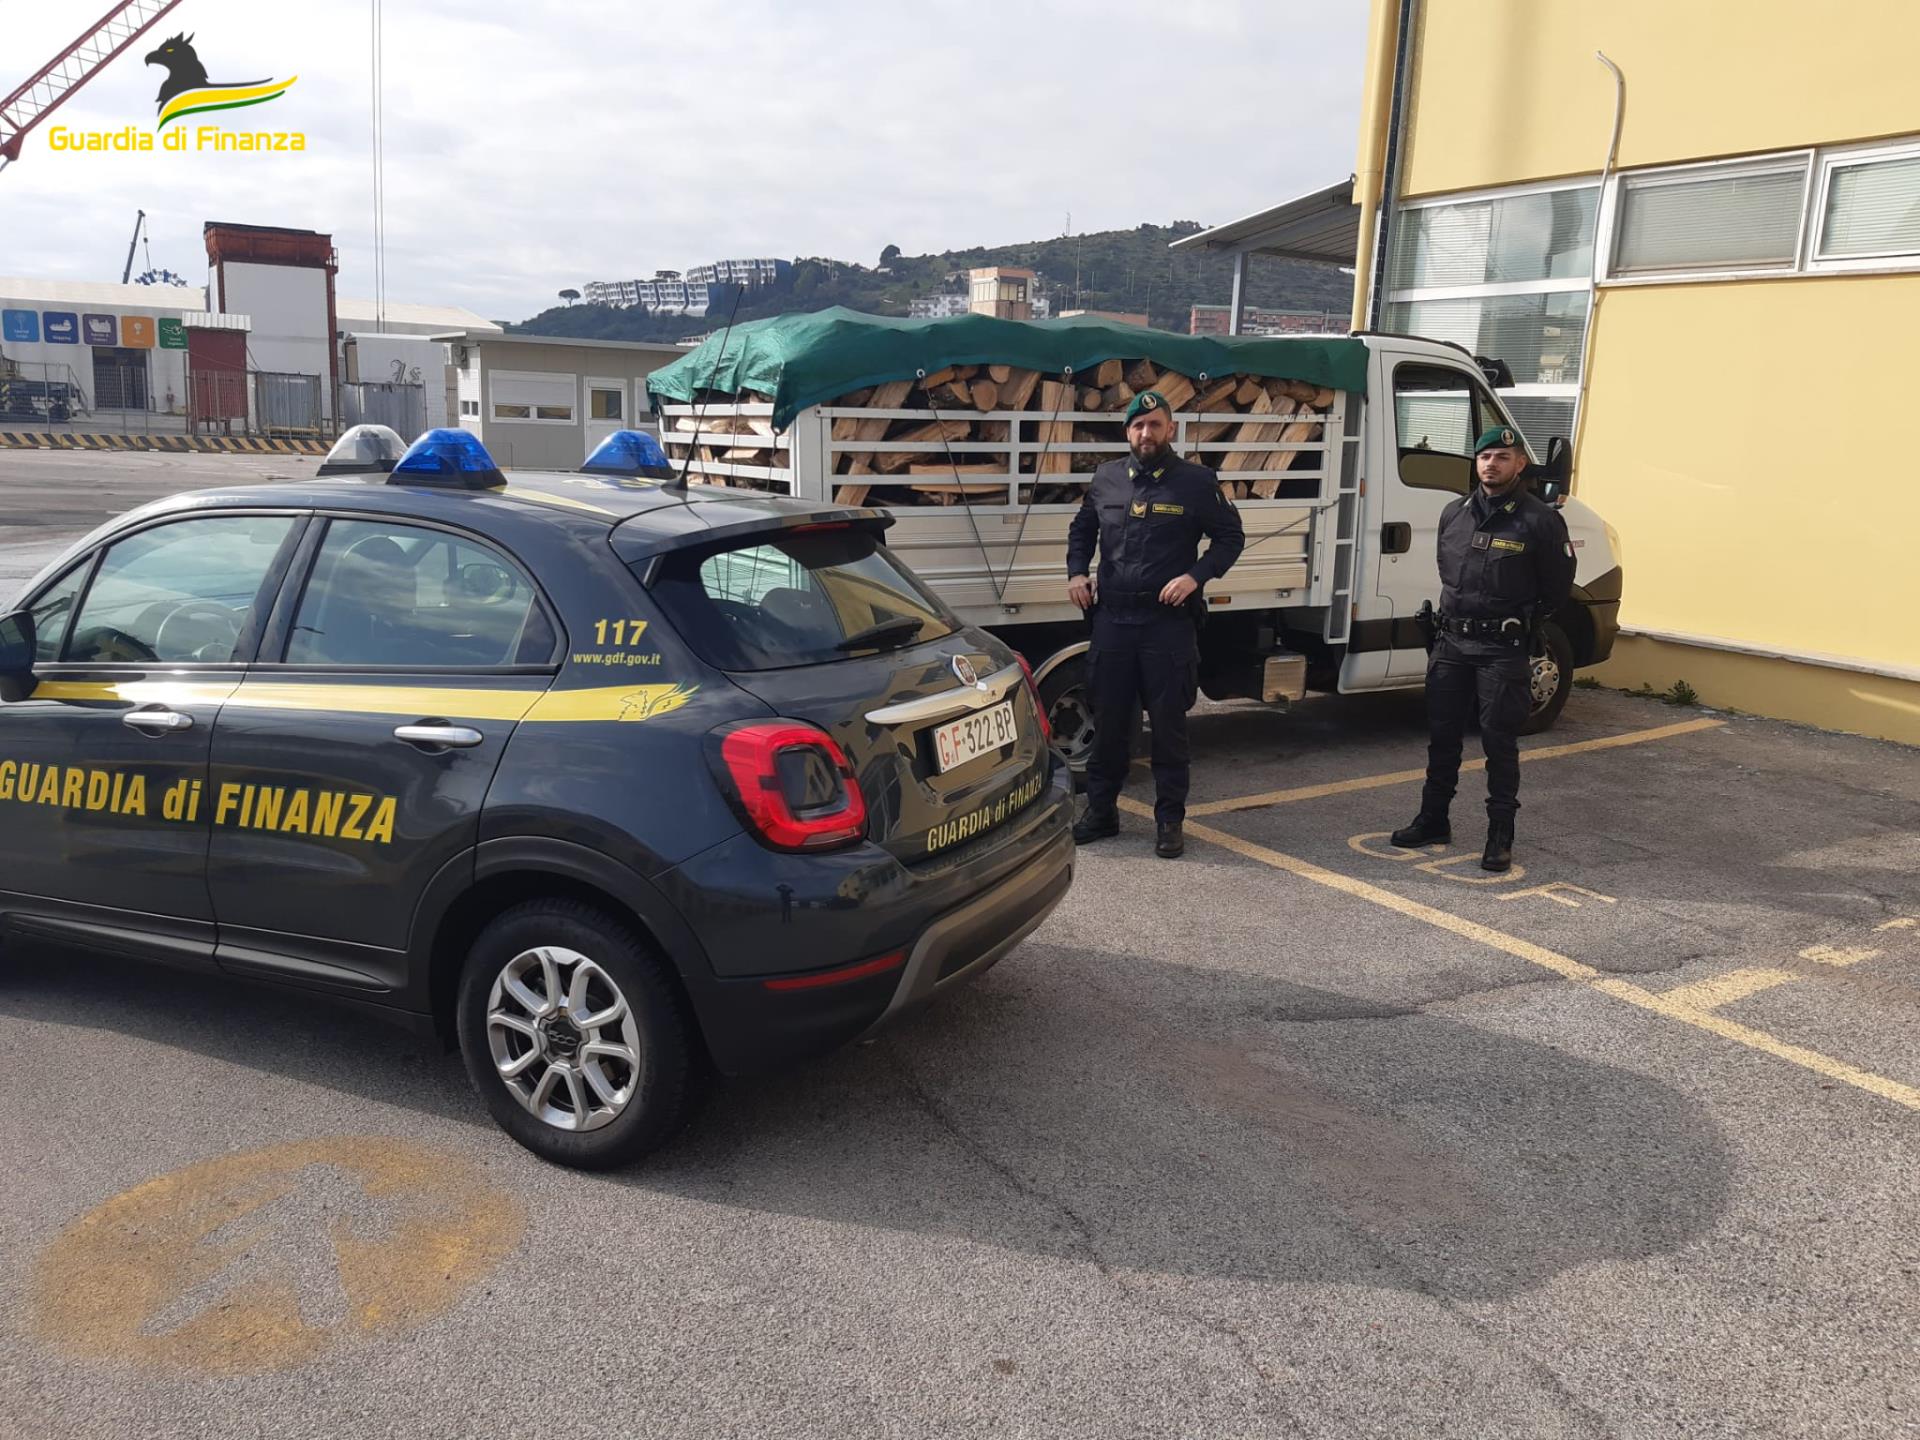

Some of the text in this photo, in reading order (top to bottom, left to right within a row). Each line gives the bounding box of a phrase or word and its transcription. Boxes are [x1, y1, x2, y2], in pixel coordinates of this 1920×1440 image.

[594, 618, 648, 645] 117
[573, 652, 661, 666] www.gdf.gov.it
[0, 760, 397, 843] GUARDIA di FINANZA
[927, 771, 1042, 852] GUARDIA di FINANZA
